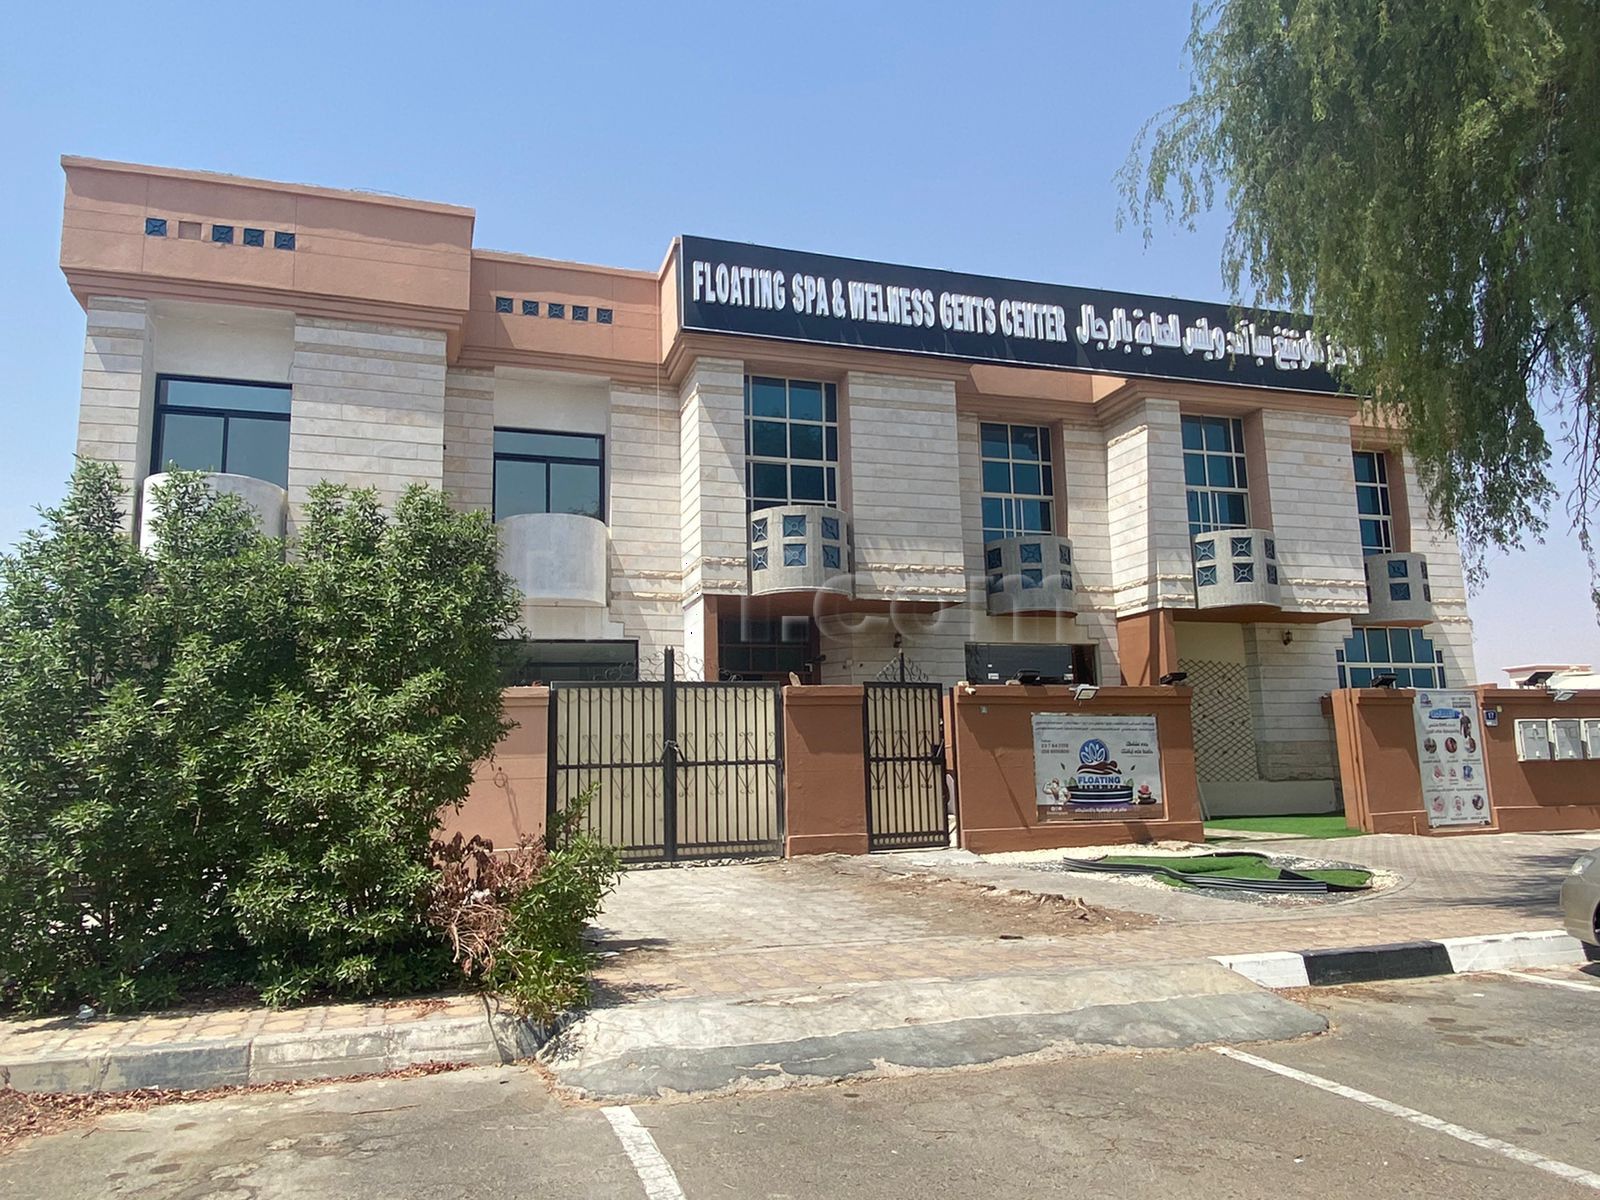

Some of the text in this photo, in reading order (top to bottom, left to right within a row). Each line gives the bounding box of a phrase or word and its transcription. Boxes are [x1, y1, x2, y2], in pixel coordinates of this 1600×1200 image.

[692, 260, 1068, 342] FLOATING SPA & WELNESS GENTS CENTER
[1076, 303, 1133, 354] بالرجال
[1077, 776, 1121, 785] FLOATING
